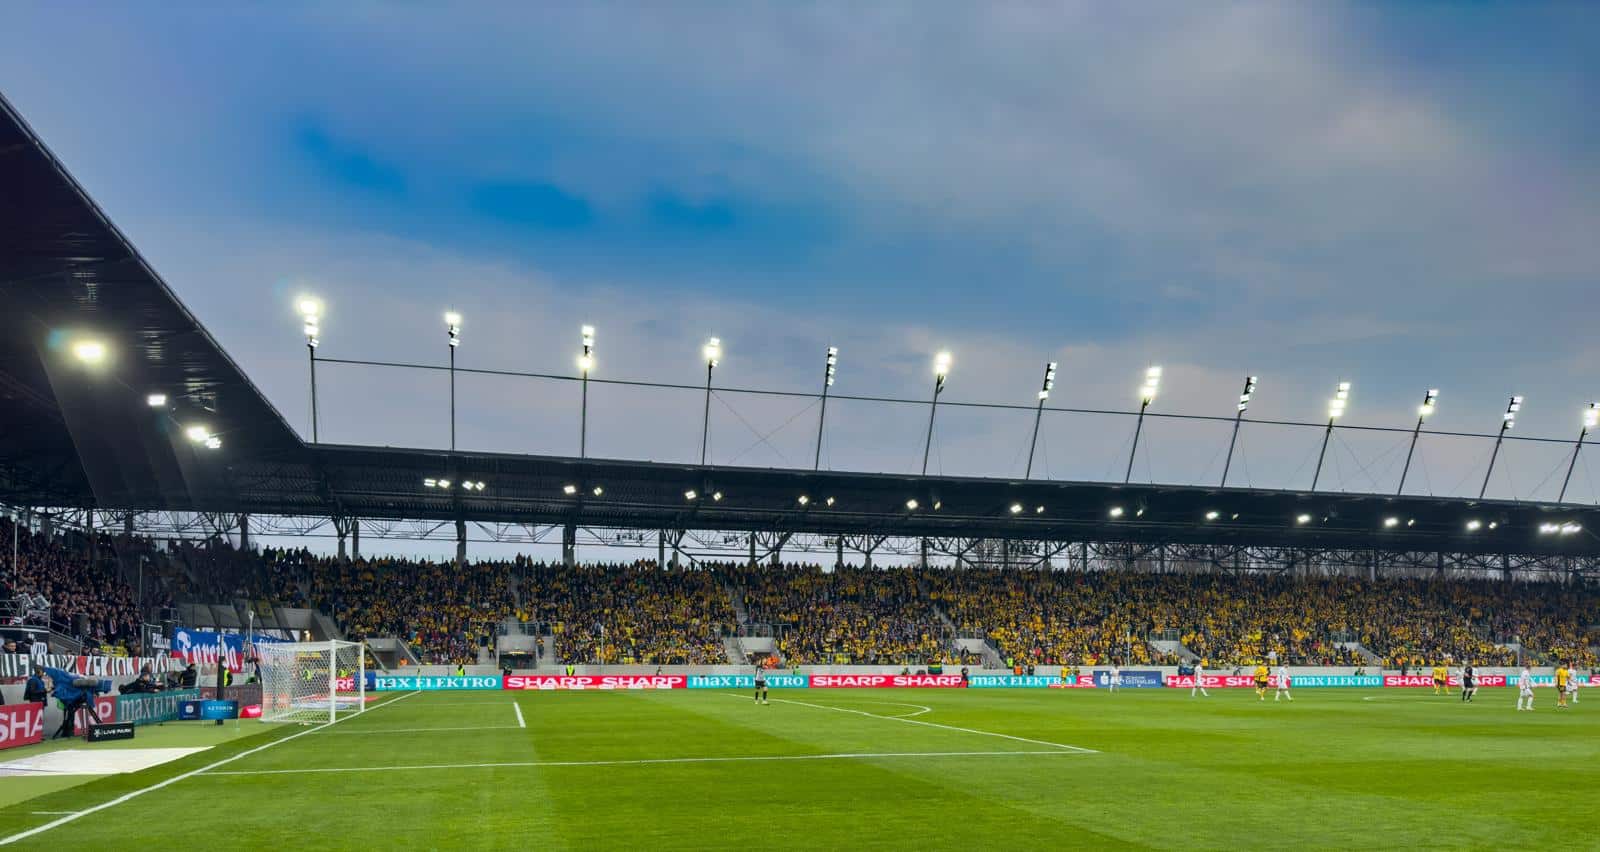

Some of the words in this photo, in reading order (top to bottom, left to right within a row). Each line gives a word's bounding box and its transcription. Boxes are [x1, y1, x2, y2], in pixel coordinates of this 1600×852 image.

[376, 677, 409, 688] max
[416, 677, 497, 688] ELEKTRO
[507, 677, 592, 687] SHARP
[601, 677, 682, 686] SHARP
[693, 677, 730, 686] max
[735, 677, 803, 686] ELKTRO
[813, 677, 885, 686] SHARP
[894, 677, 962, 686] SHARP
[973, 677, 1007, 686] max
[1295, 677, 1323, 685] max
[1327, 677, 1380, 685] ELEKTRO
[1387, 676, 1435, 685] SHAR
[120, 699, 150, 720] max
